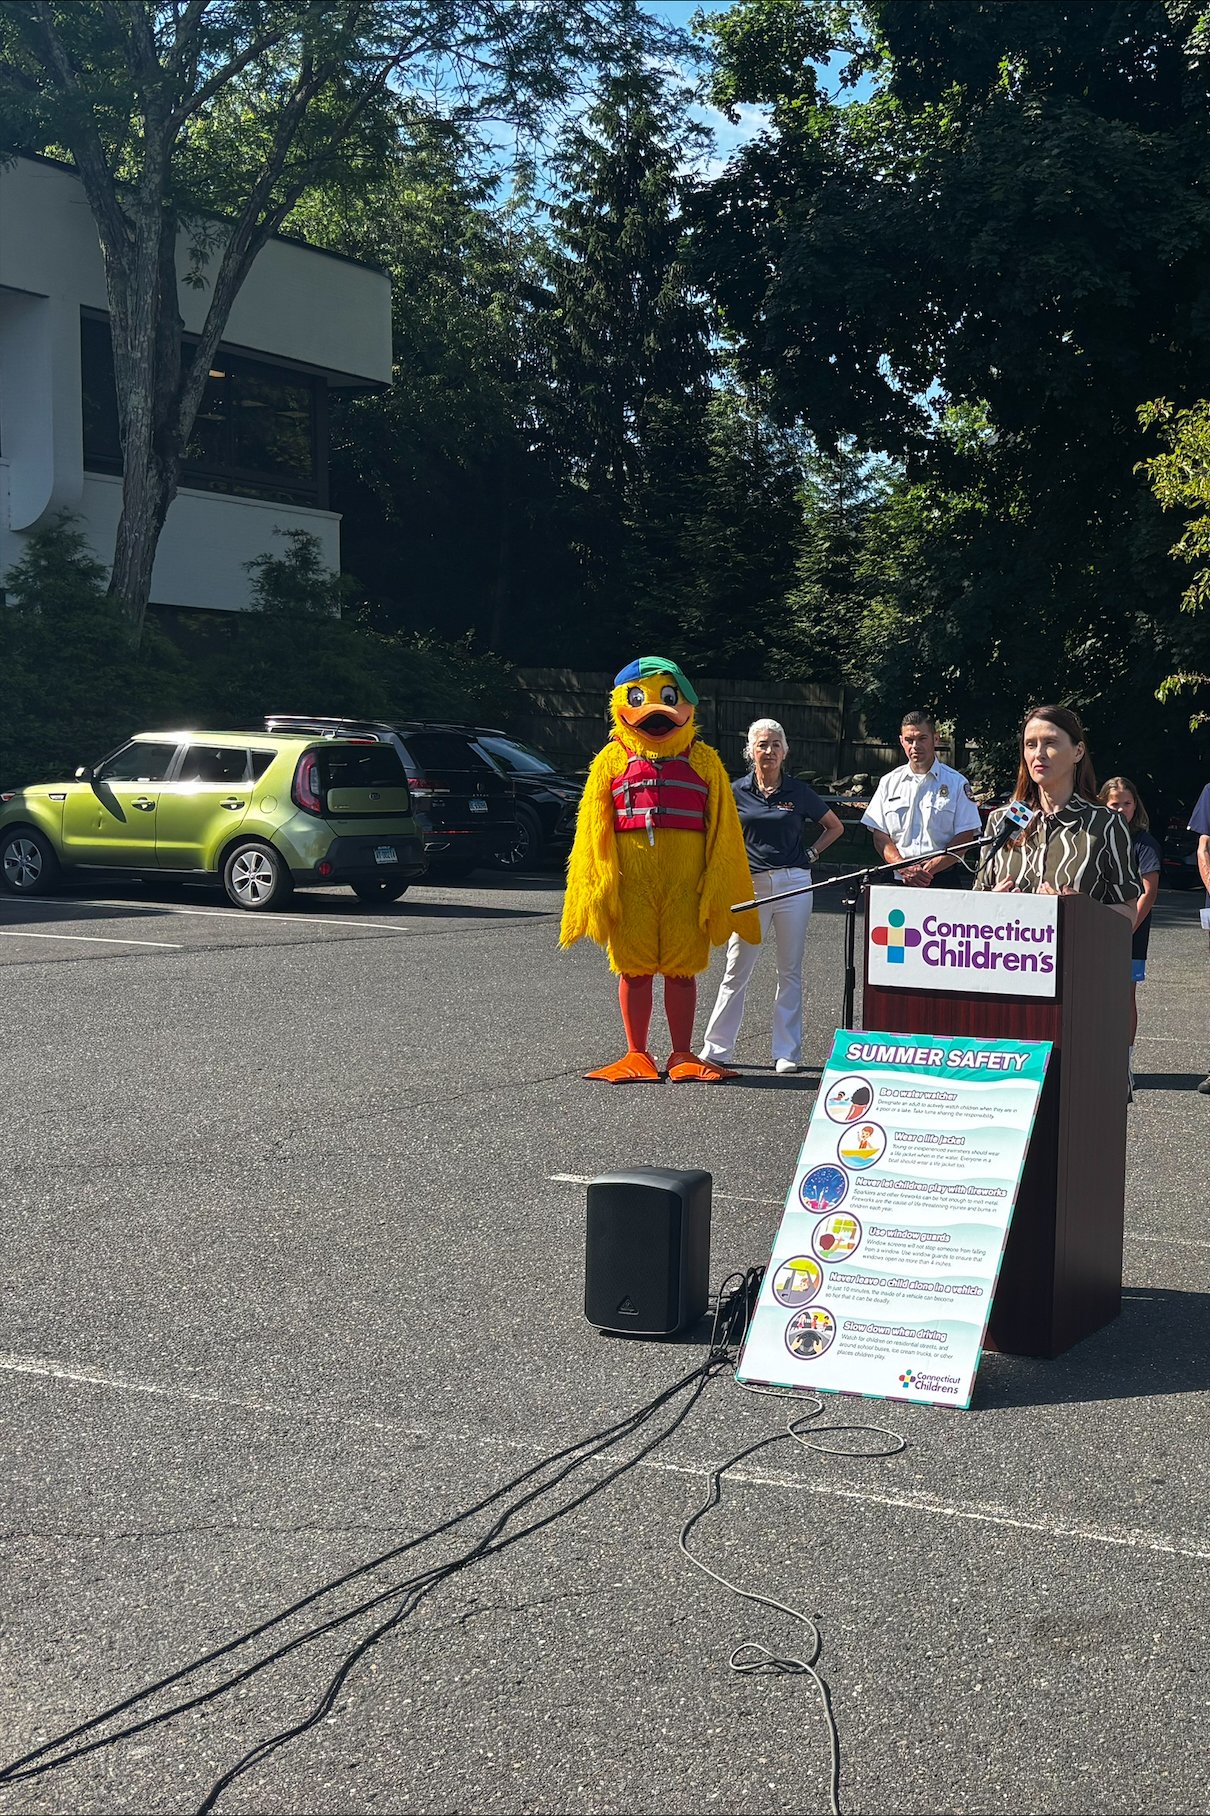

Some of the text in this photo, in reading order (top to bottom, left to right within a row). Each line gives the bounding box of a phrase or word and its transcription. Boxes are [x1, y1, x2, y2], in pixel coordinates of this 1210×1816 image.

[922, 915, 1055, 943] Connecticut
[921, 939, 1055, 973] Children's
[846, 1043, 1031, 1071] SUMMER SAFETY
[879, 1087, 957, 1100] Be a water watcher
[894, 1131, 965, 1145] Wear a life jacket
[855, 1176, 1007, 1197] Never let children play with fireworks
[868, 1226, 950, 1242] Use window guards
[829, 1271, 983, 1295] Never leave a child alone in a vehicle
[842, 1320, 947, 1342] Slow down when driving
[917, 1372, 961, 1384] Connecticut
